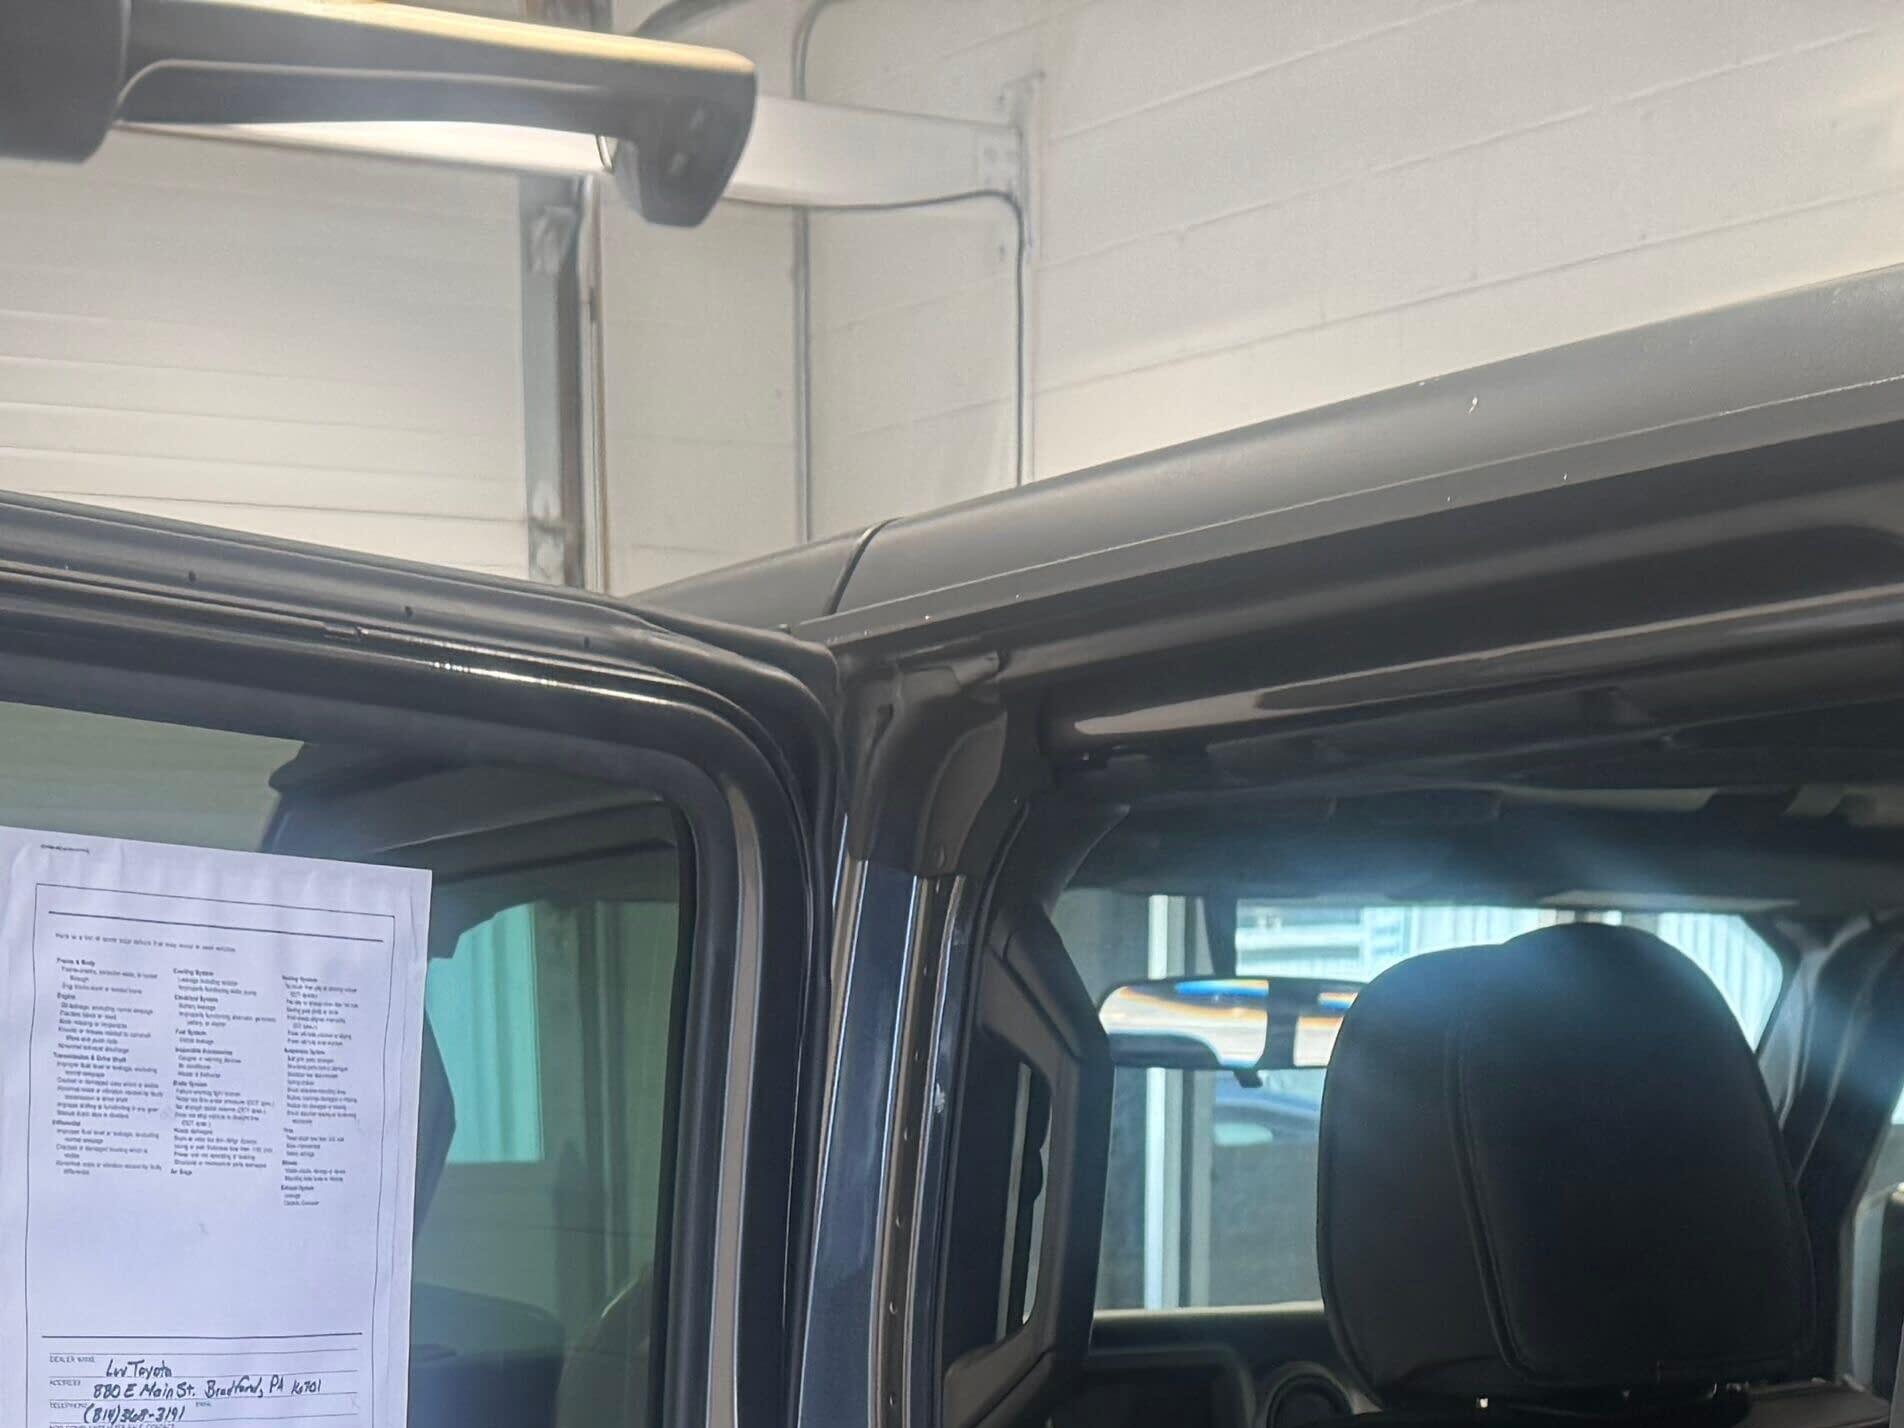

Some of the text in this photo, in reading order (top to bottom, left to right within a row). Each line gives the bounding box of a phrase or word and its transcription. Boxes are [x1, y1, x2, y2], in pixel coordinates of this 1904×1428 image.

[127, 1359, 172, 1380] Toyota
[93, 1383, 121, 1399] 880
[124, 1383, 137, 1398] E
[139, 1381, 174, 1399] Main
[177, 1381, 196, 1398] St.
[269, 1374, 284, 1393] PA
